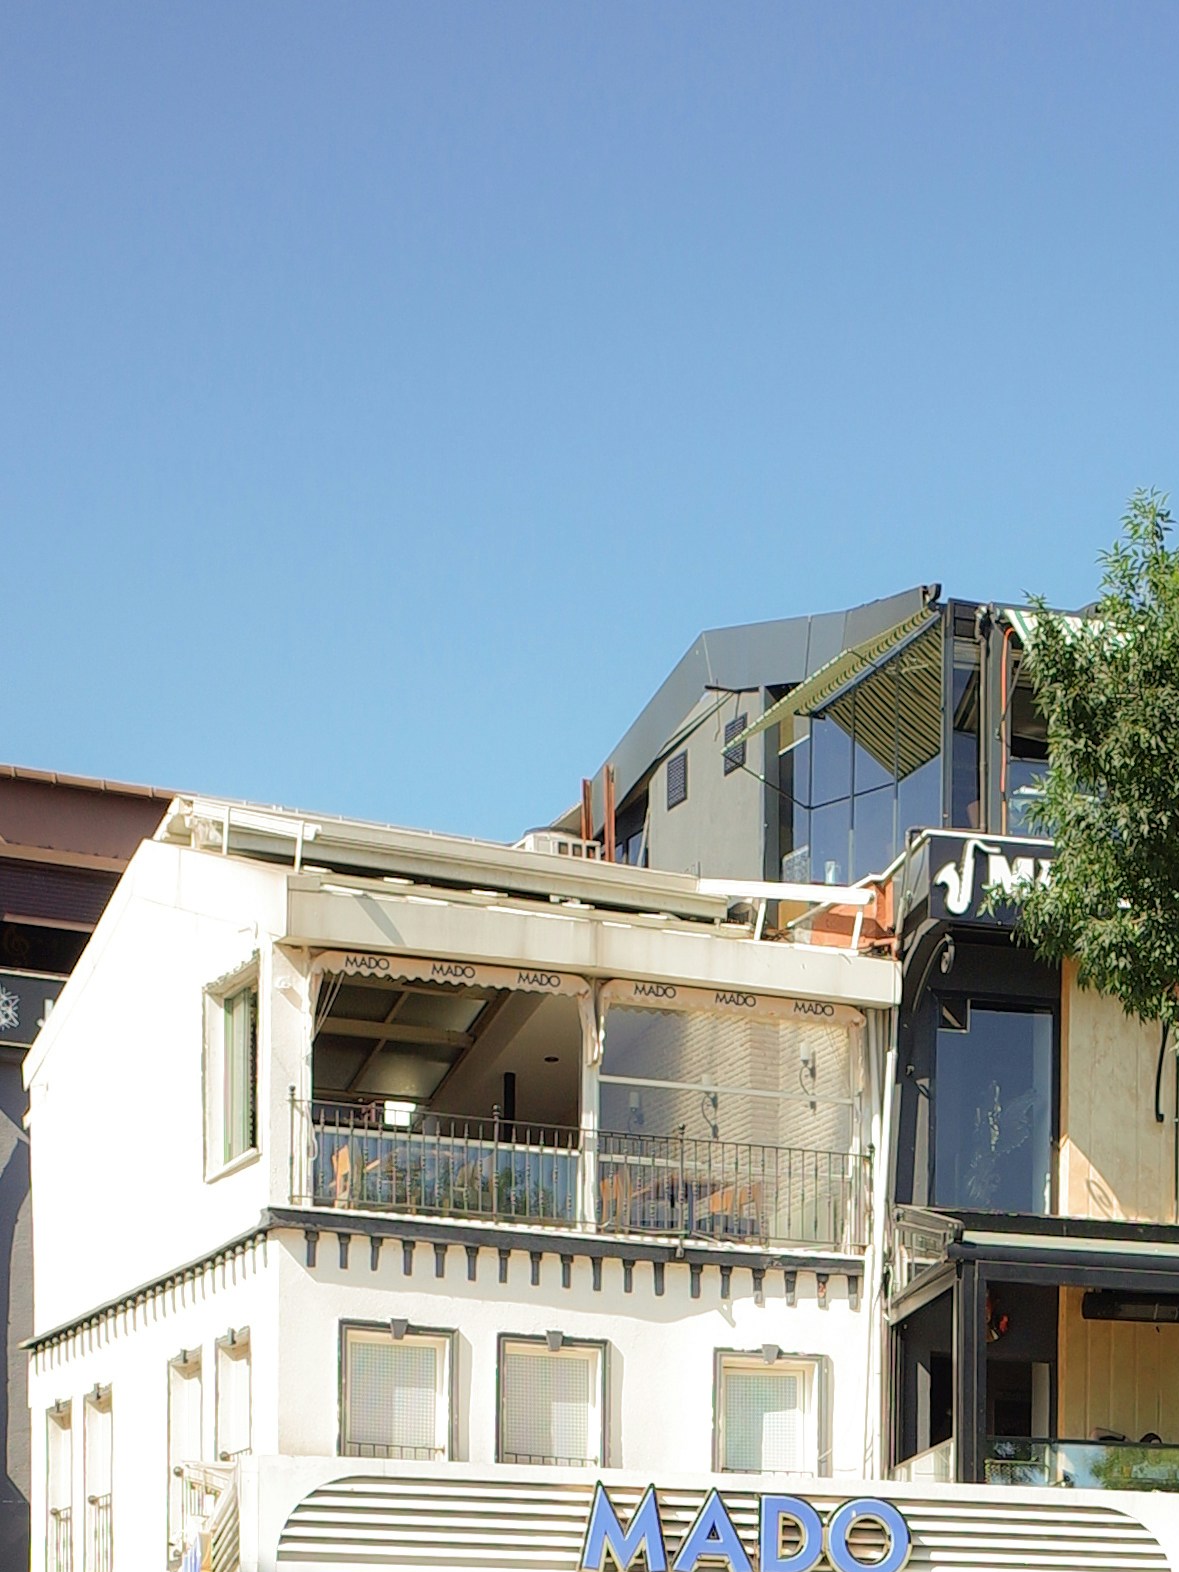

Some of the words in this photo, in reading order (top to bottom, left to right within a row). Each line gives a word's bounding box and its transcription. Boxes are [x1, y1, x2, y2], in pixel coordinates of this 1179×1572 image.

[344, 955, 390, 971] MADO
[430, 963, 476, 979] MADO
[516, 971, 561, 987] MADO
[633, 982, 677, 999] MADO
[714, 992, 757, 1008] MADO
[793, 1001, 835, 1017] MADO
